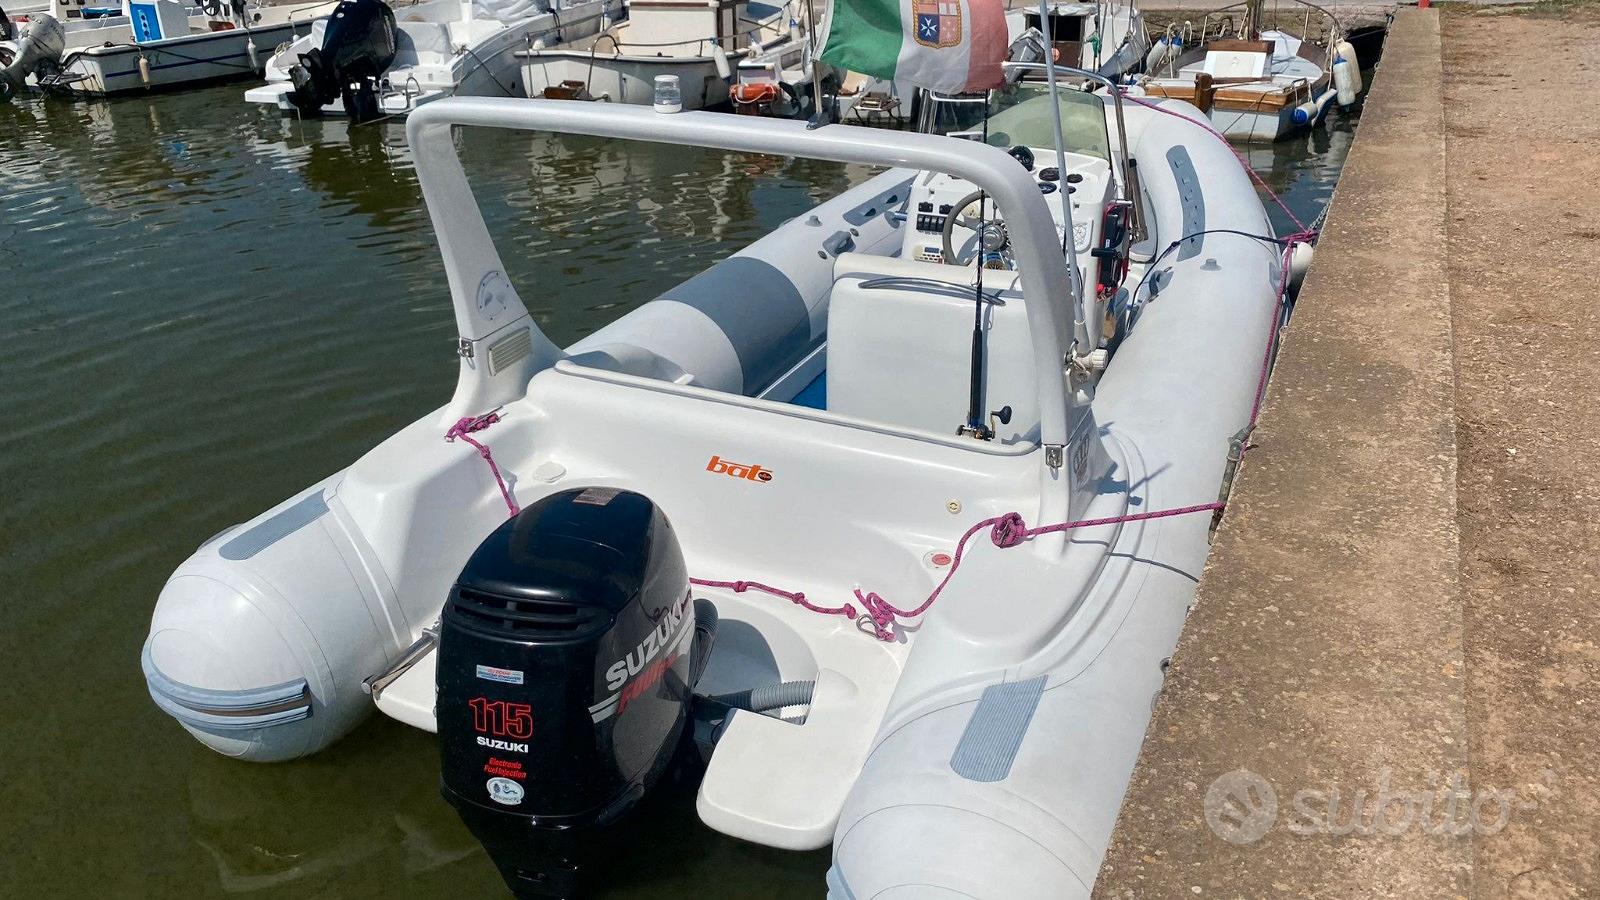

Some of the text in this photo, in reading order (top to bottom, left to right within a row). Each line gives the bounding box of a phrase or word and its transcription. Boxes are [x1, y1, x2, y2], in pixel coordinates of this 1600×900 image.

[606, 597, 682, 691] SUZUKI
[469, 697, 533, 739] 115
[476, 736, 529, 753] SUZUKI
[489, 757, 522, 769] Electronic
